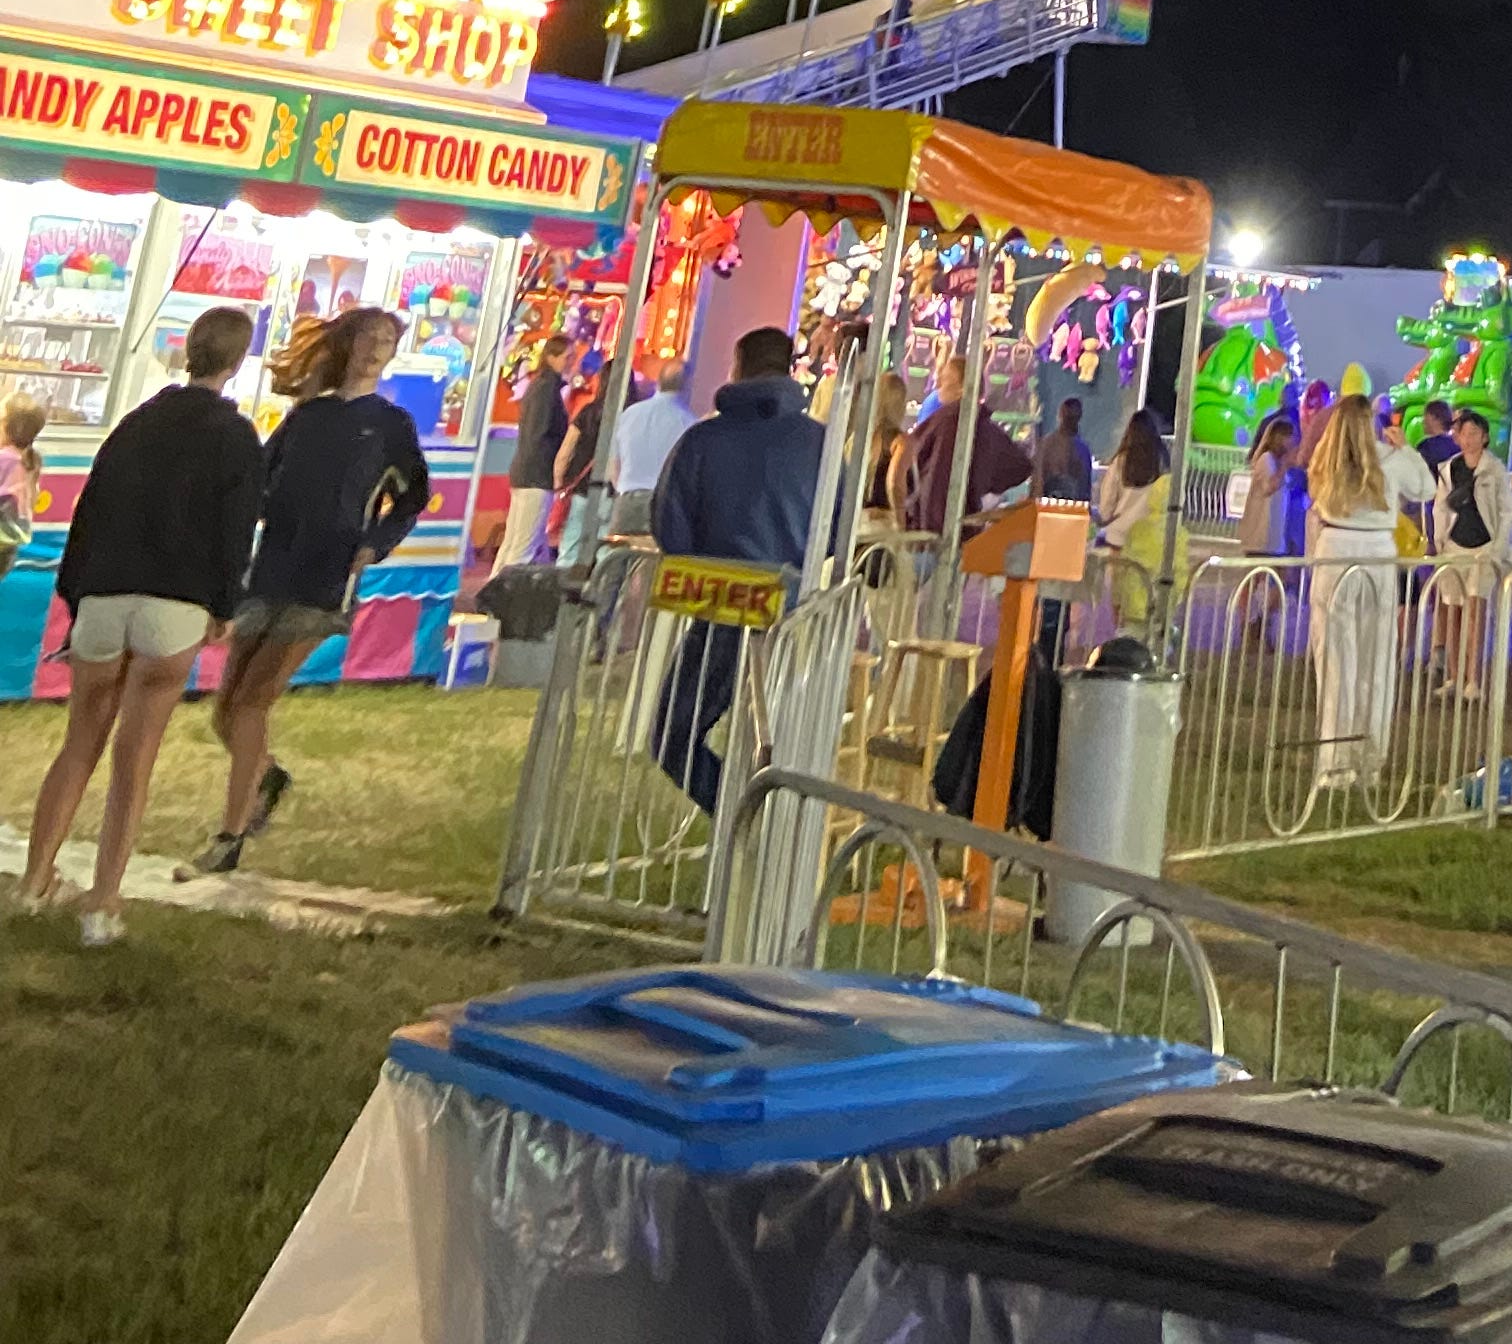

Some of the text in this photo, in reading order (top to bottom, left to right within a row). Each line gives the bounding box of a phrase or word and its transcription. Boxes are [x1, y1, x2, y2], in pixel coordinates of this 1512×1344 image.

[102, 85, 253, 150] APPLES
[356, 124, 591, 196] COTTON CANDY
[659, 569, 772, 616] ENTER
